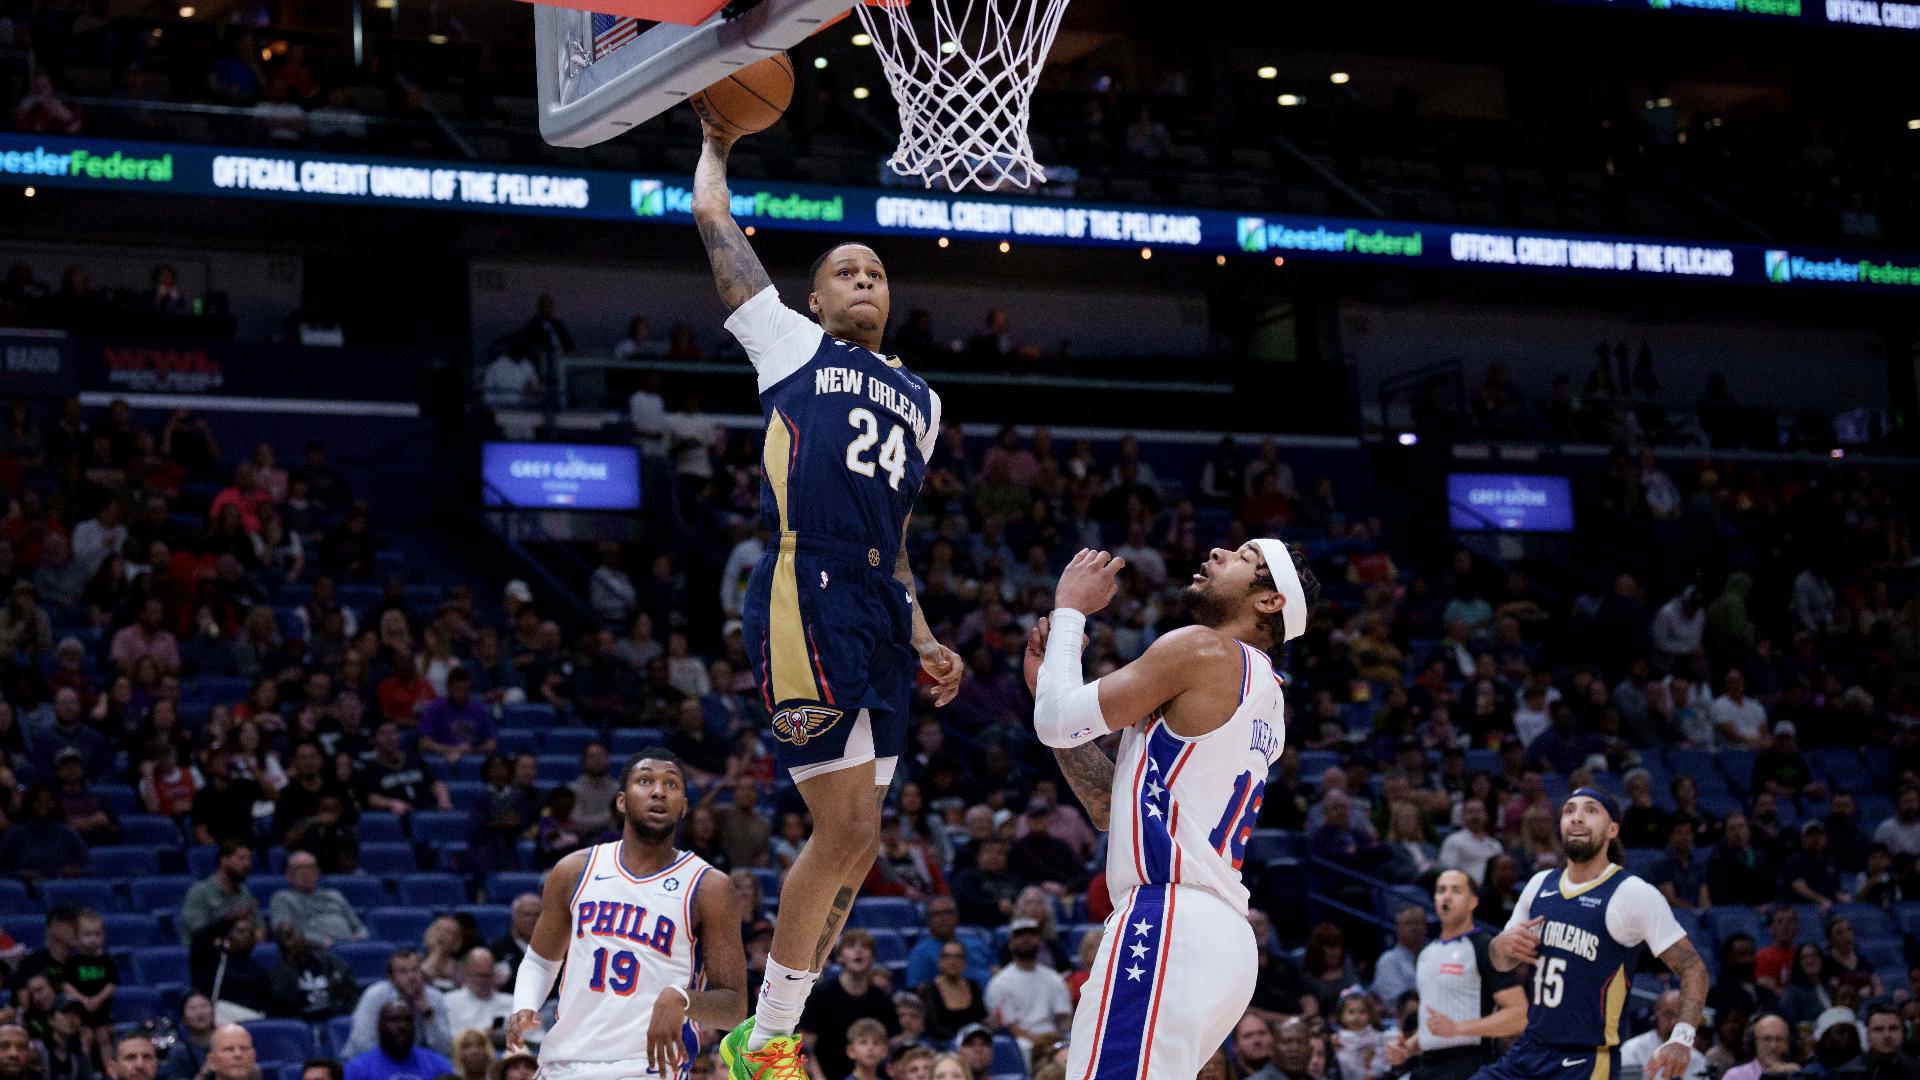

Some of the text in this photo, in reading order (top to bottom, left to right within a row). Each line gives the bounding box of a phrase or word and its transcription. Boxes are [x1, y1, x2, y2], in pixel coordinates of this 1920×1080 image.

[1826, 0, 1920, 29] OFFICIAL CREDI
[0, 146, 173, 182] eslerFederal
[212, 155, 589, 209] OFFICIAL CREDIT UNION OF THE PELICANS
[876, 196, 1201, 245] OFFICIAL CREDIT UNION OF THE PELICANS
[1450, 232, 1734, 277] OFFICIAL CREDIT UNION OF THE PELICANS
[1791, 256, 1920, 286] KeeslerFedera
[815, 367, 864, 395] NEW
[845, 407, 907, 492] 24
[576, 901, 677, 958] PHILA
[1543, 921, 1600, 962] ORLEANS
[589, 947, 641, 996] 19
[1533, 955, 1567, 1009] 15
